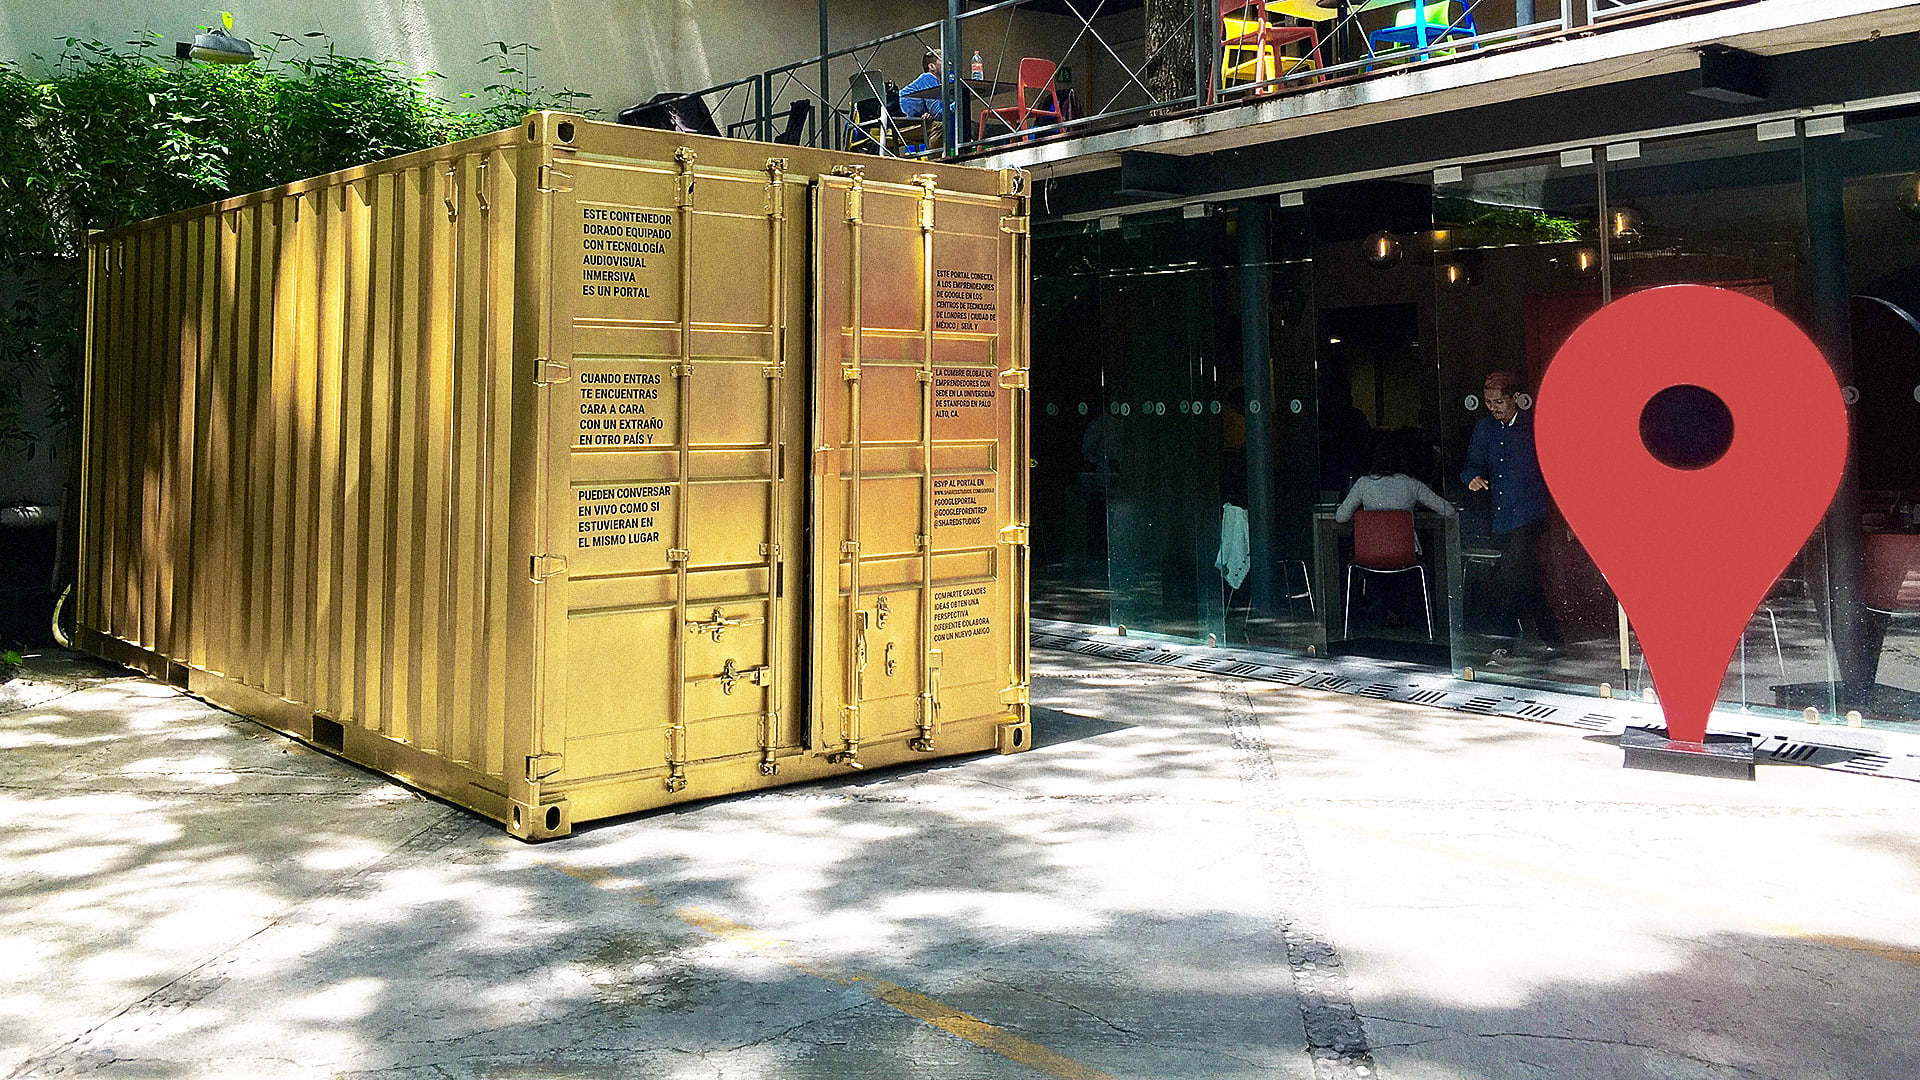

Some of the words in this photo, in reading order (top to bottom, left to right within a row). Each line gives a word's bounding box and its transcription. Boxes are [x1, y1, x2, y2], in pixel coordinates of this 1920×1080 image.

[584, 209, 607, 220] ESTE
[610, 211, 671, 224] CONTENEDOR
[584, 224, 623, 236] DORADO
[626, 227, 671, 239] EQUIPADO
[583, 239, 603, 250] CON
[606, 241, 665, 253] TECNOLOGÍA
[583, 255, 646, 267] AUDIOVISUAL
[583, 270, 635, 282] INMERSIVA
[951, 271, 969, 279] PORTAL
[583, 285, 594, 295] ES
[598, 286, 610, 296] UN
[614, 287, 649, 297] PORTAL
[953, 282, 994, 290] EMPRENDEDORES
[945, 291, 964, 299] GOOGLE
[937, 301, 959, 309] CENTROS
[936, 321, 955, 329] MÉXICO
[581, 373, 620, 383] CUANDO
[624, 374, 660, 384] ENTRAS
[581, 389, 592, 398] TE
[595, 389, 657, 399] ENCUENTRAS
[580, 404, 606, 414] CARA
[610, 404, 616, 414] A
[619, 404, 644, 414] CARA
[580, 420, 600, 429] CON
[603, 420, 616, 429] UN
[620, 417, 663, 429] EXTRAÑO
[580, 435, 592, 444] EN
[595, 435, 620, 444] OTRO
[624, 432, 644, 444] PAÍS
[647, 434, 653, 444] Y
[579, 489, 614, 501] PUEDEN
[617, 486, 670, 498] CONVERSAR
[579, 506, 591, 516] EN
[594, 504, 617, 515] VIVO
[620, 503, 648, 514] COMO
[651, 502, 659, 511] SI
[579, 519, 638, 532] ESTUVIERAN
[641, 517, 653, 527] EN
[934, 518, 980, 529] @SHAREDSTUDIOS
[579, 538, 590, 547] EL
[593, 535, 625, 546] MISMO
[629, 532, 659, 543] LUGAR
[935, 590, 962, 600] COMPARTE
[963, 587, 986, 596] GRANDES
[935, 602, 949, 610] IDEAS
[951, 600, 967, 608] OBTEN
[935, 610, 968, 620] PERSPECTIVA
[934, 621, 961, 631] DIFERENTE
[962, 618, 989, 627] COLABORA
[955, 630, 972, 639] NUEVO
[973, 627, 990, 635] AMIGO
